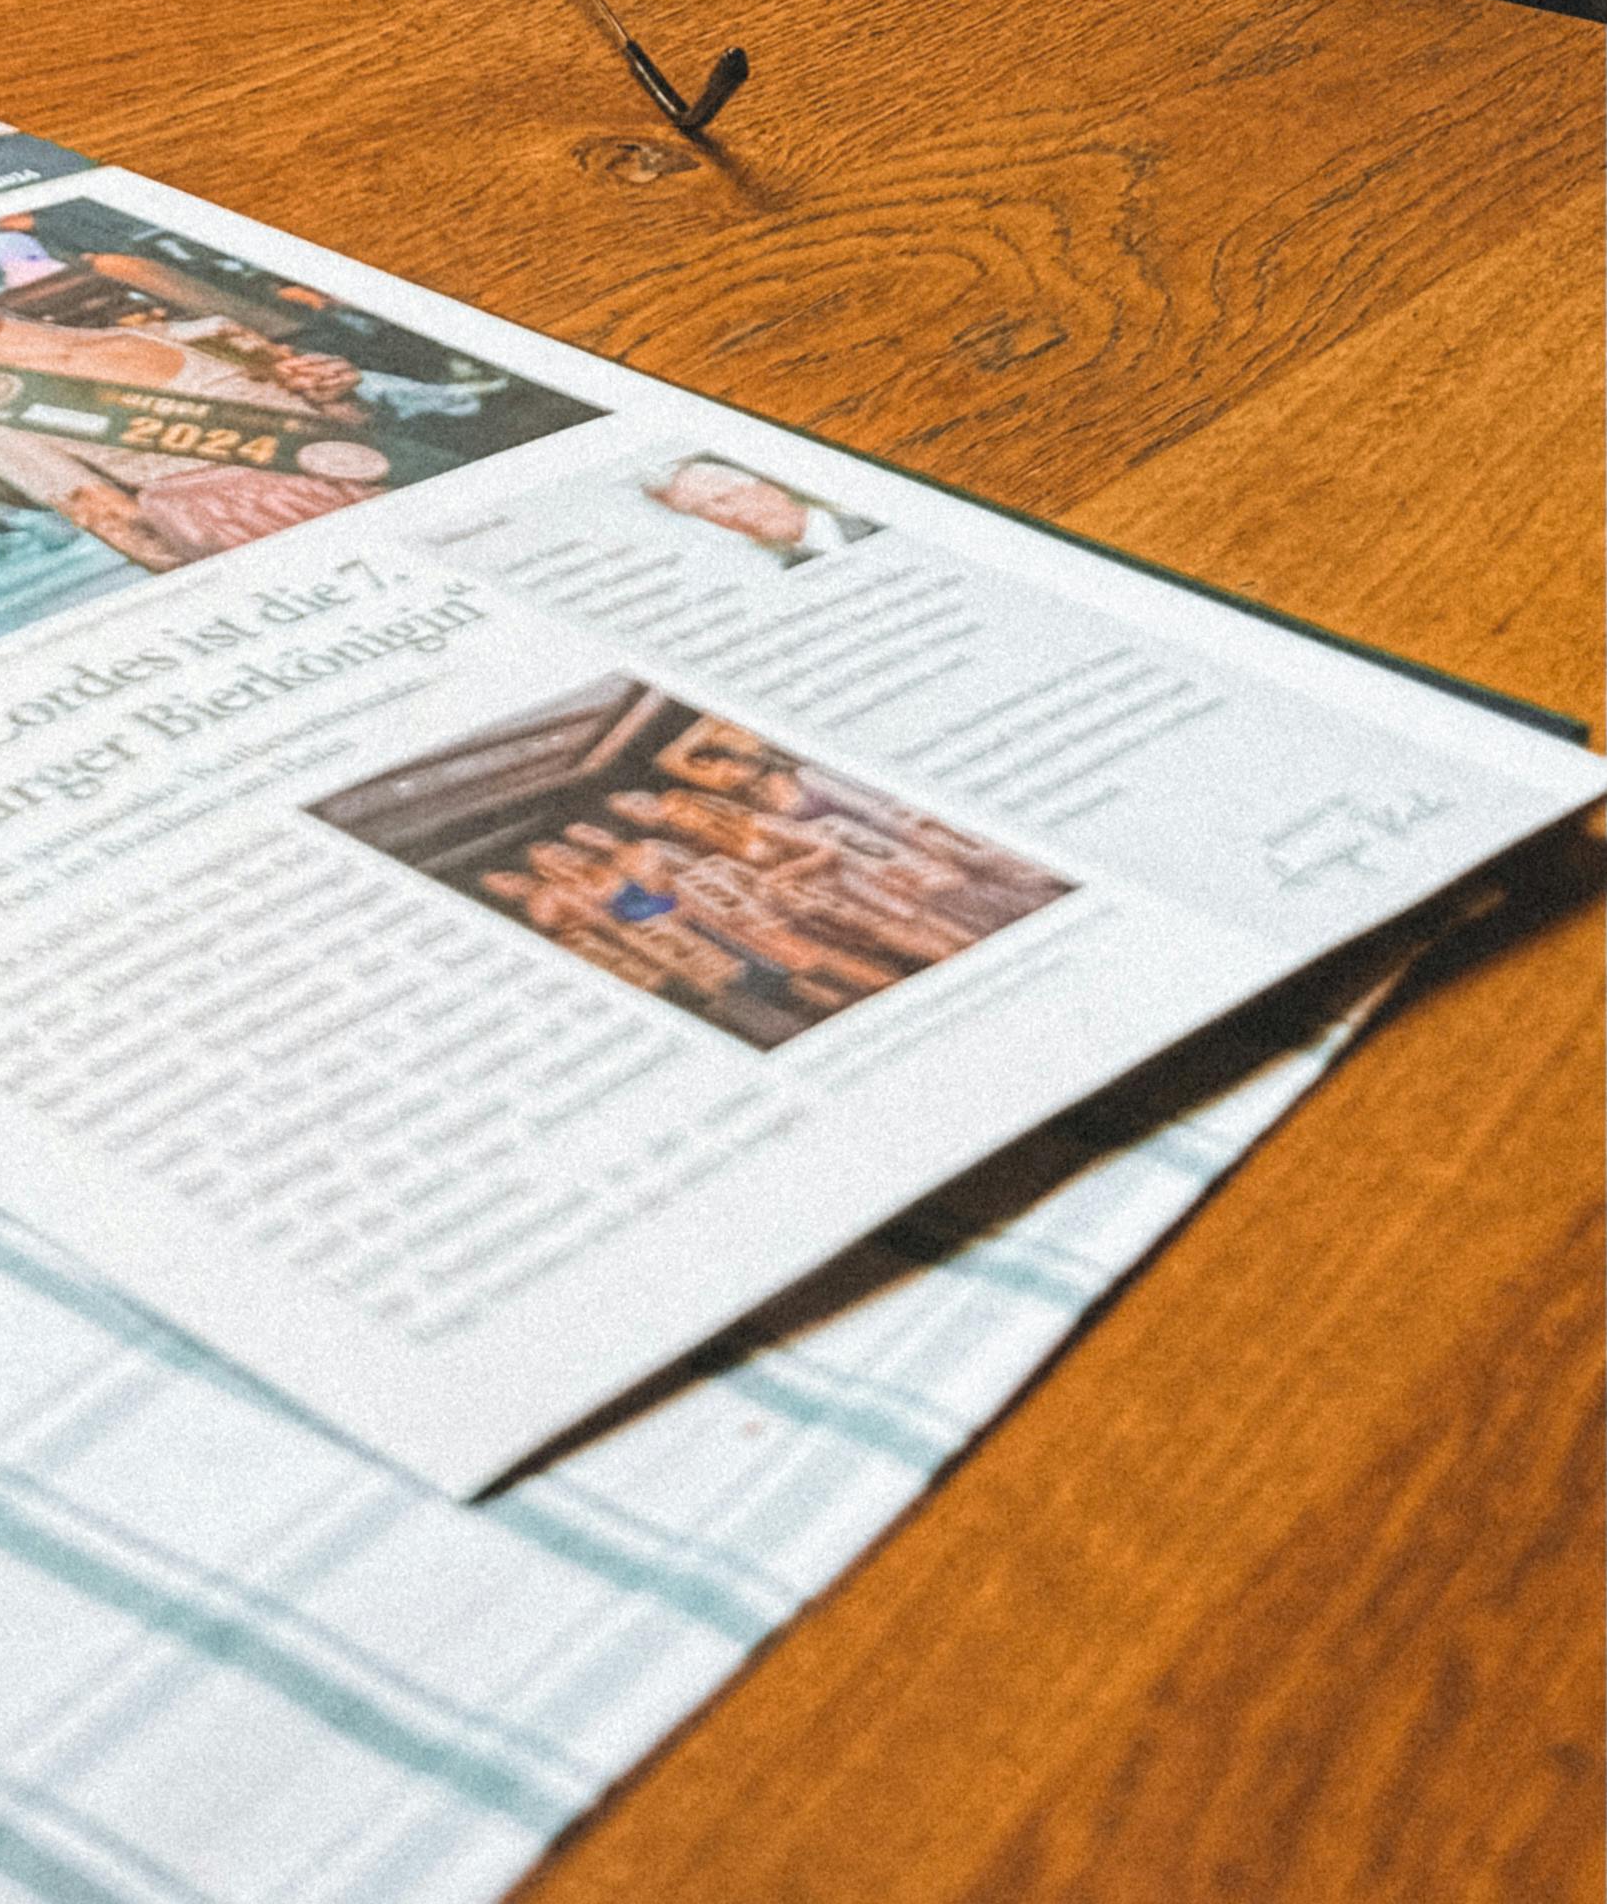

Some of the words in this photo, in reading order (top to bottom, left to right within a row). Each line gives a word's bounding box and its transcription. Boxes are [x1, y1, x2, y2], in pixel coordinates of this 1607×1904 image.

[120, 415, 280, 466] 2024
[161, 615, 261, 659] ist
[258, 578, 355, 627] die
[335, 558, 411, 591] 7.
